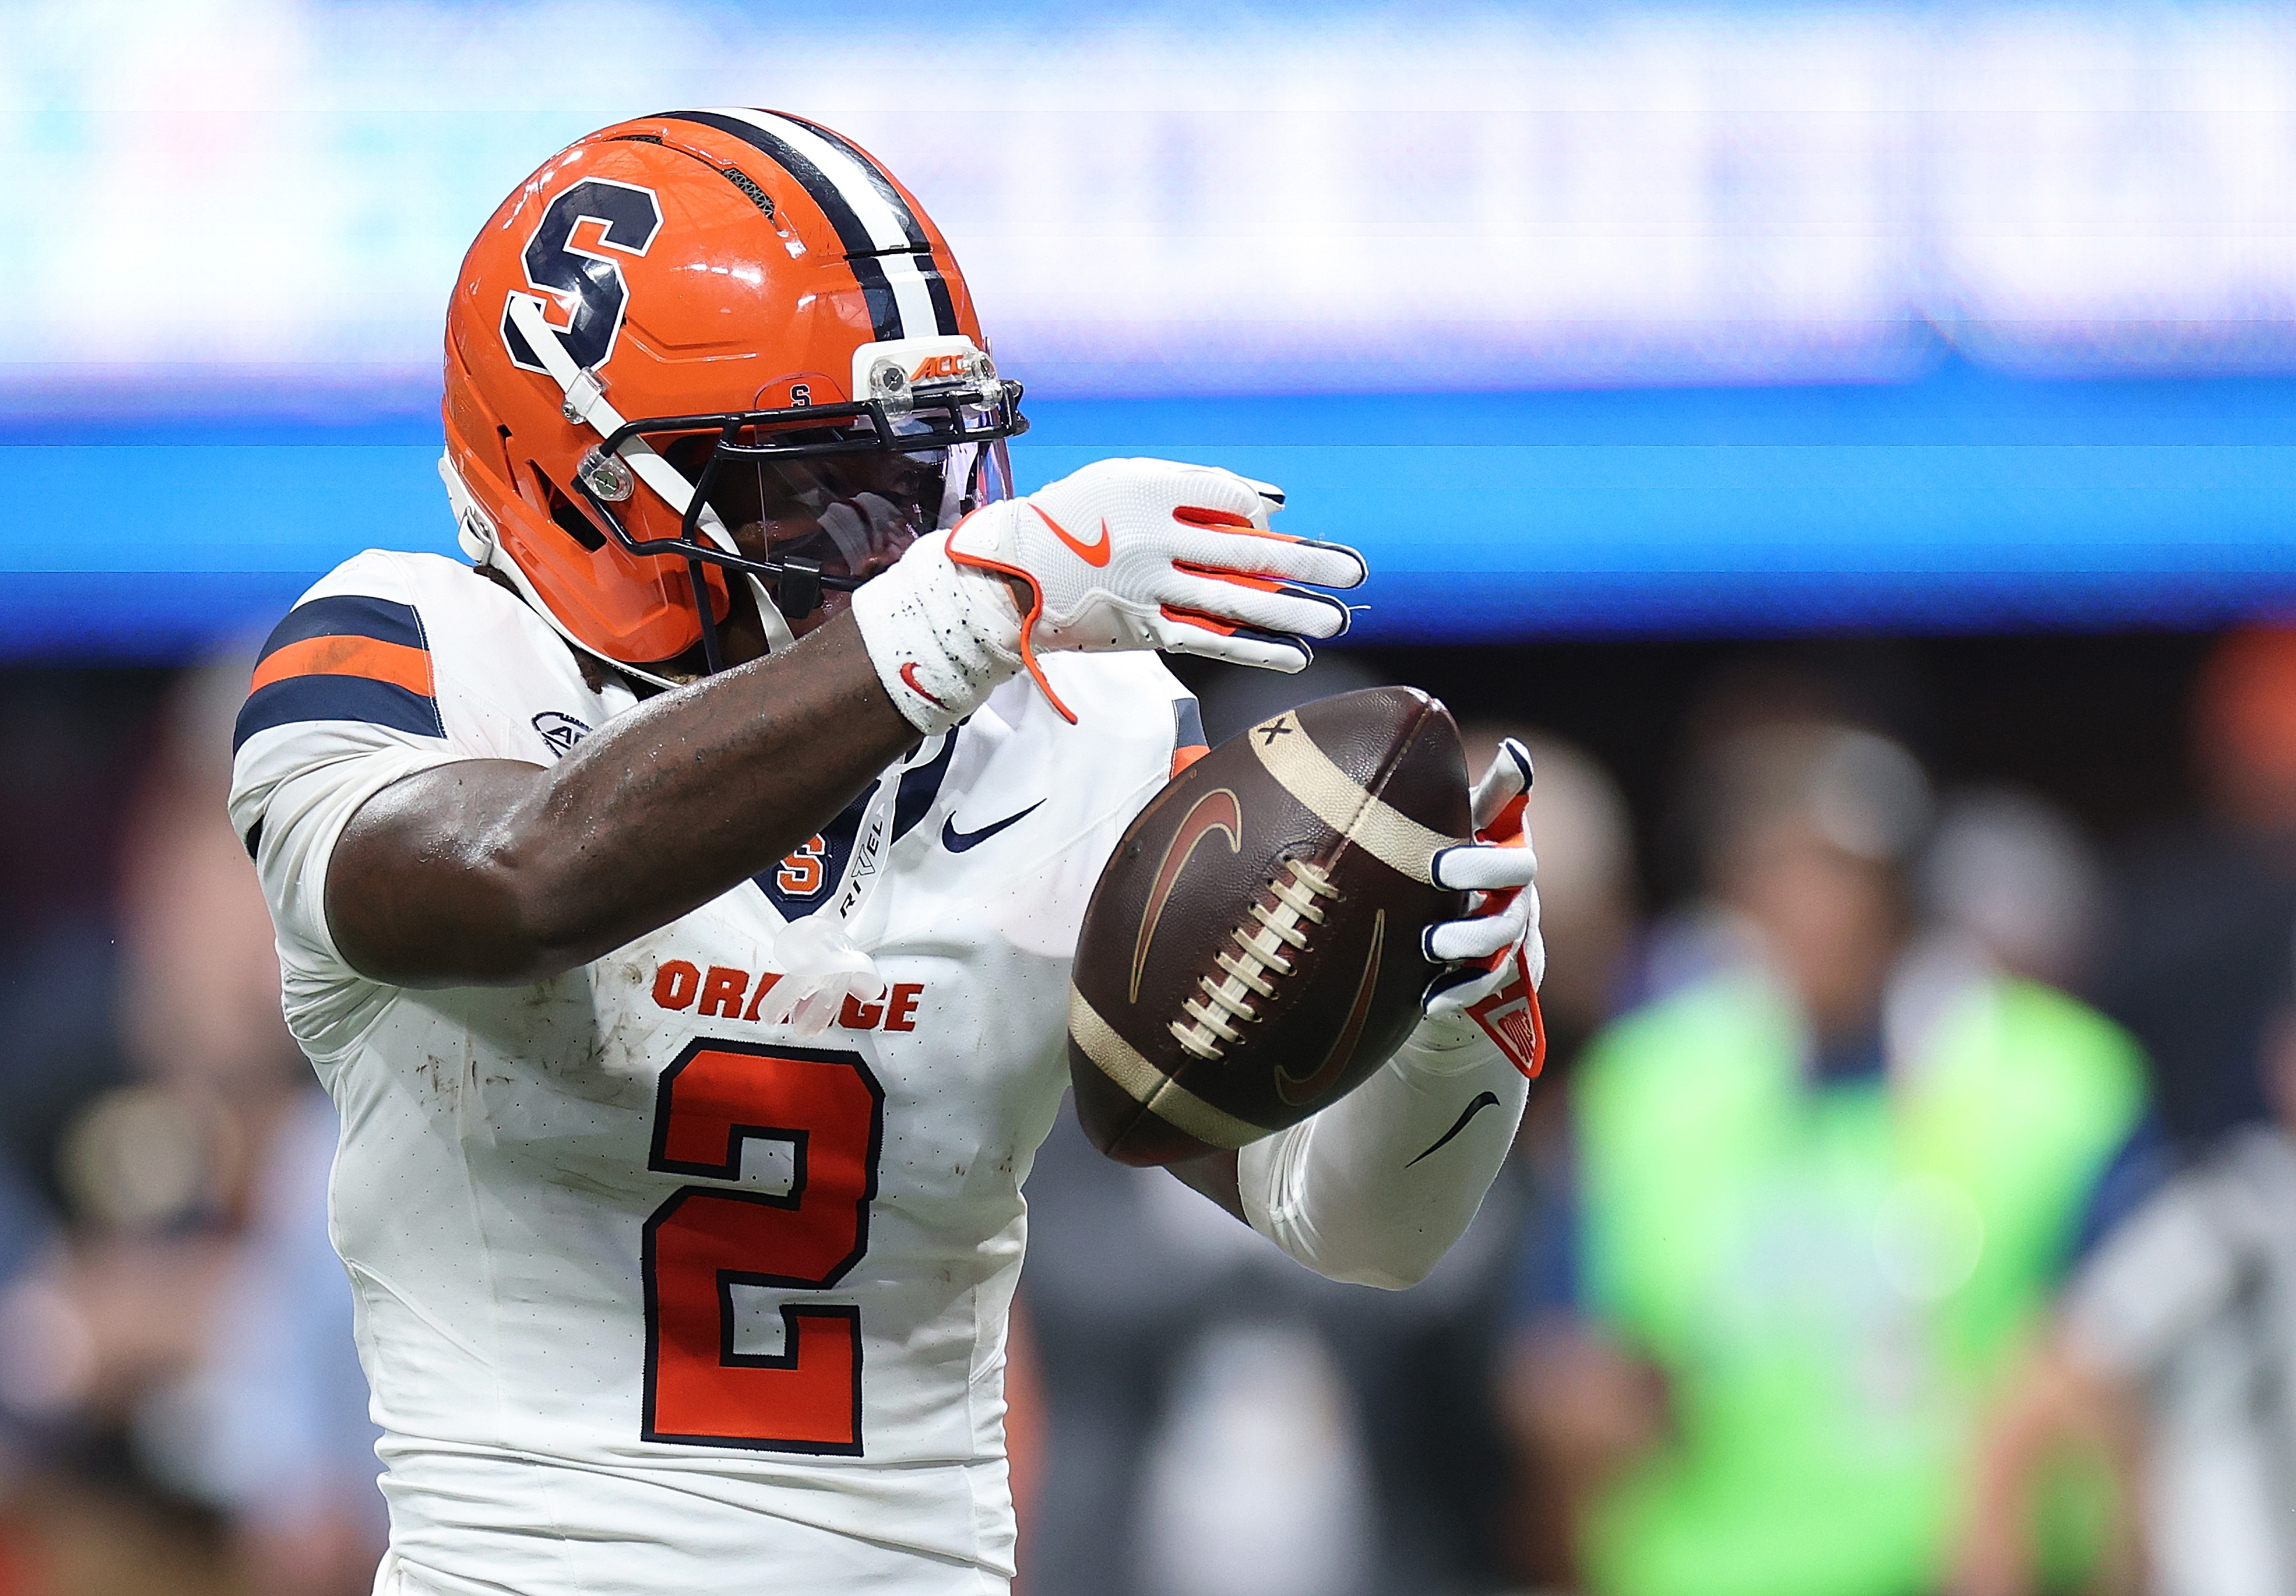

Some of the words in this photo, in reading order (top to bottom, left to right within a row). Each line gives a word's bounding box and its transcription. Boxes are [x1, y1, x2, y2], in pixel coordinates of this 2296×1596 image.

[499, 175, 665, 378] S
[790, 384, 811, 408] S
[909, 354, 966, 381] ACC
[777, 833, 826, 896] S
[651, 959, 925, 1033] ORGE
[640, 1035, 886, 1458] 2
